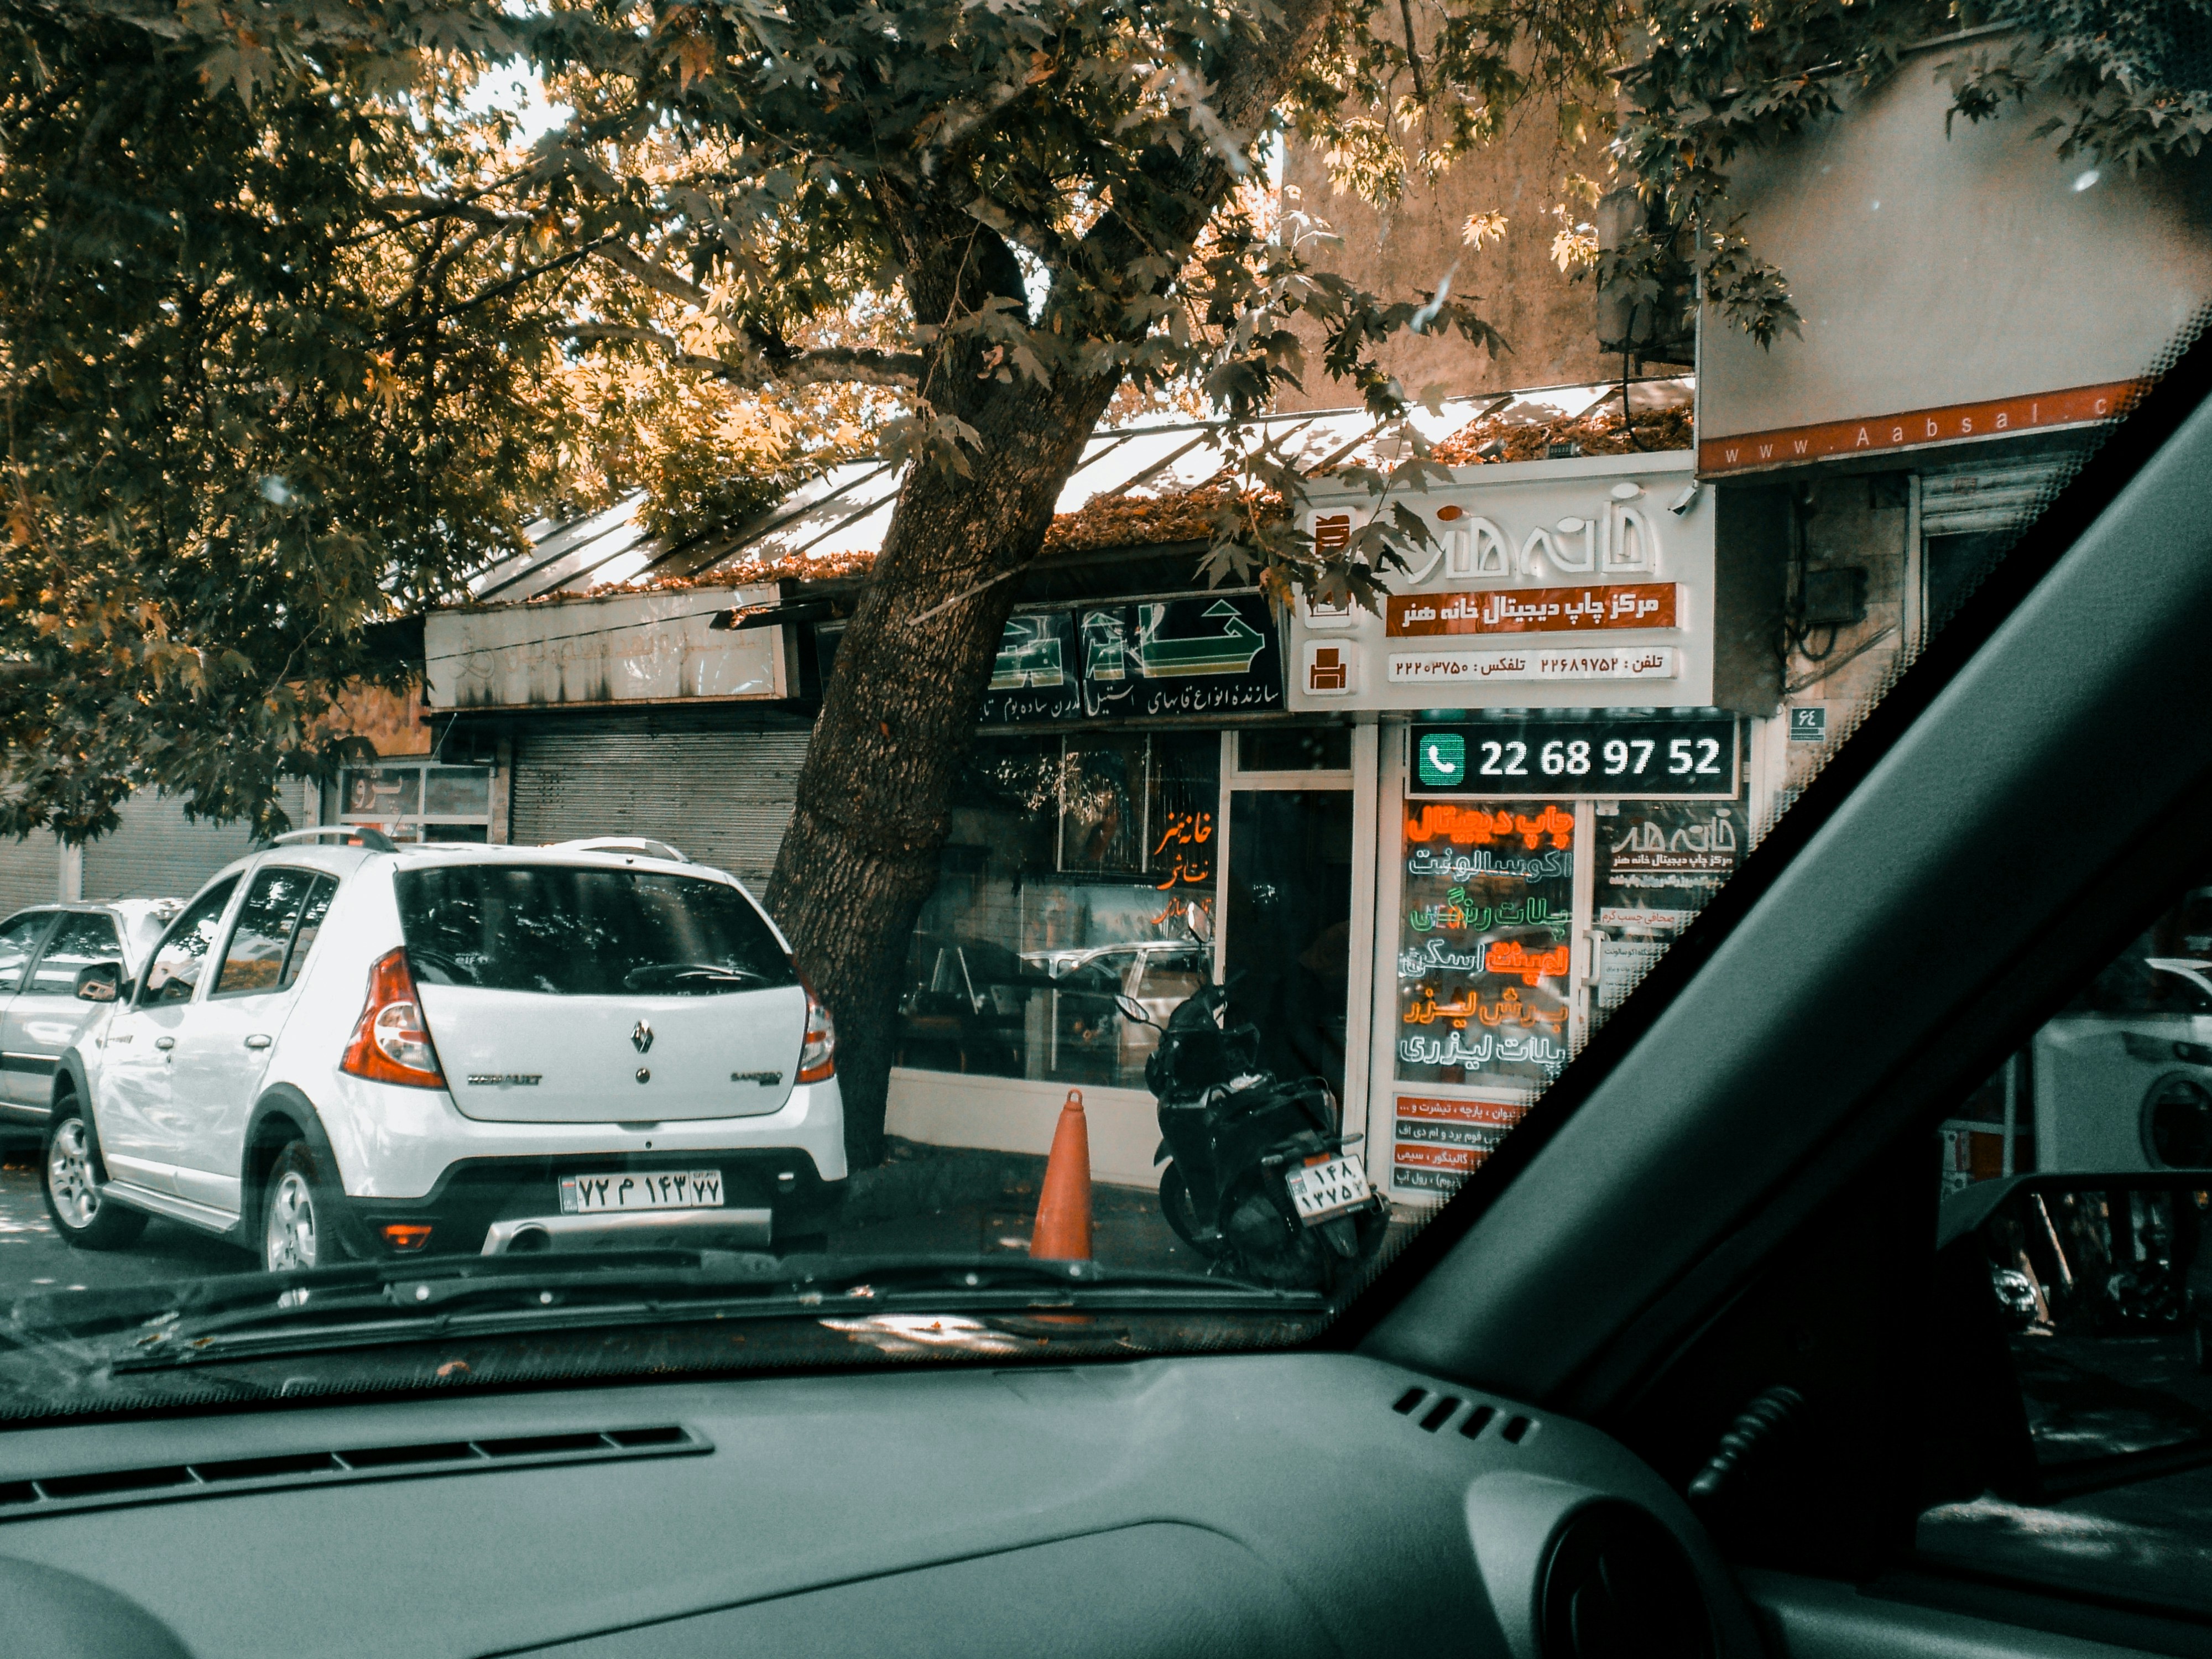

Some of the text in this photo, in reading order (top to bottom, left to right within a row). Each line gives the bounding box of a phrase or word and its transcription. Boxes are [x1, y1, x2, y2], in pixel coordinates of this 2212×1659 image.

[1725, 398, 2107, 463] www.Aabsal.c
[1520, 483, 1656, 576] خانه
[1402, 592, 1659, 628] مرکز چاپ دیجیتال خانه هنر
[1541, 657, 1619, 673] ۲۲۶۸۹۷۵۲
[1004, 696, 1020, 722] بوم
[1020, 697, 1047, 714] ساده
[1193, 686, 1229, 710] انواع
[1480, 738, 1721, 775] 22 68 97 52
[1178, 811, 1212, 844] خانه
[1408, 805, 1574, 850] چاپ دیجیتال
[1670, 808, 1736, 852] خانه
[1613, 854, 1733, 868] مرکز چاپ دیجیتال خانه هنر
[1495, 897, 1568, 941] پلات
[1618, 914, 1642, 924] چسب
[1404, 988, 1478, 1028] لیزر
[1400, 1031, 1493, 1070] لیزری
[1412, 1104, 1417, 1113] و
[1419, 1103, 1452, 1114] تیشرت
[1459, 1107, 1483, 1119] پارچه
[1314, 1161, 1353, 1185] ۱۴۸
[578, 1176, 719, 1207] ۷۲ م ۱۴۳ ۷۷
